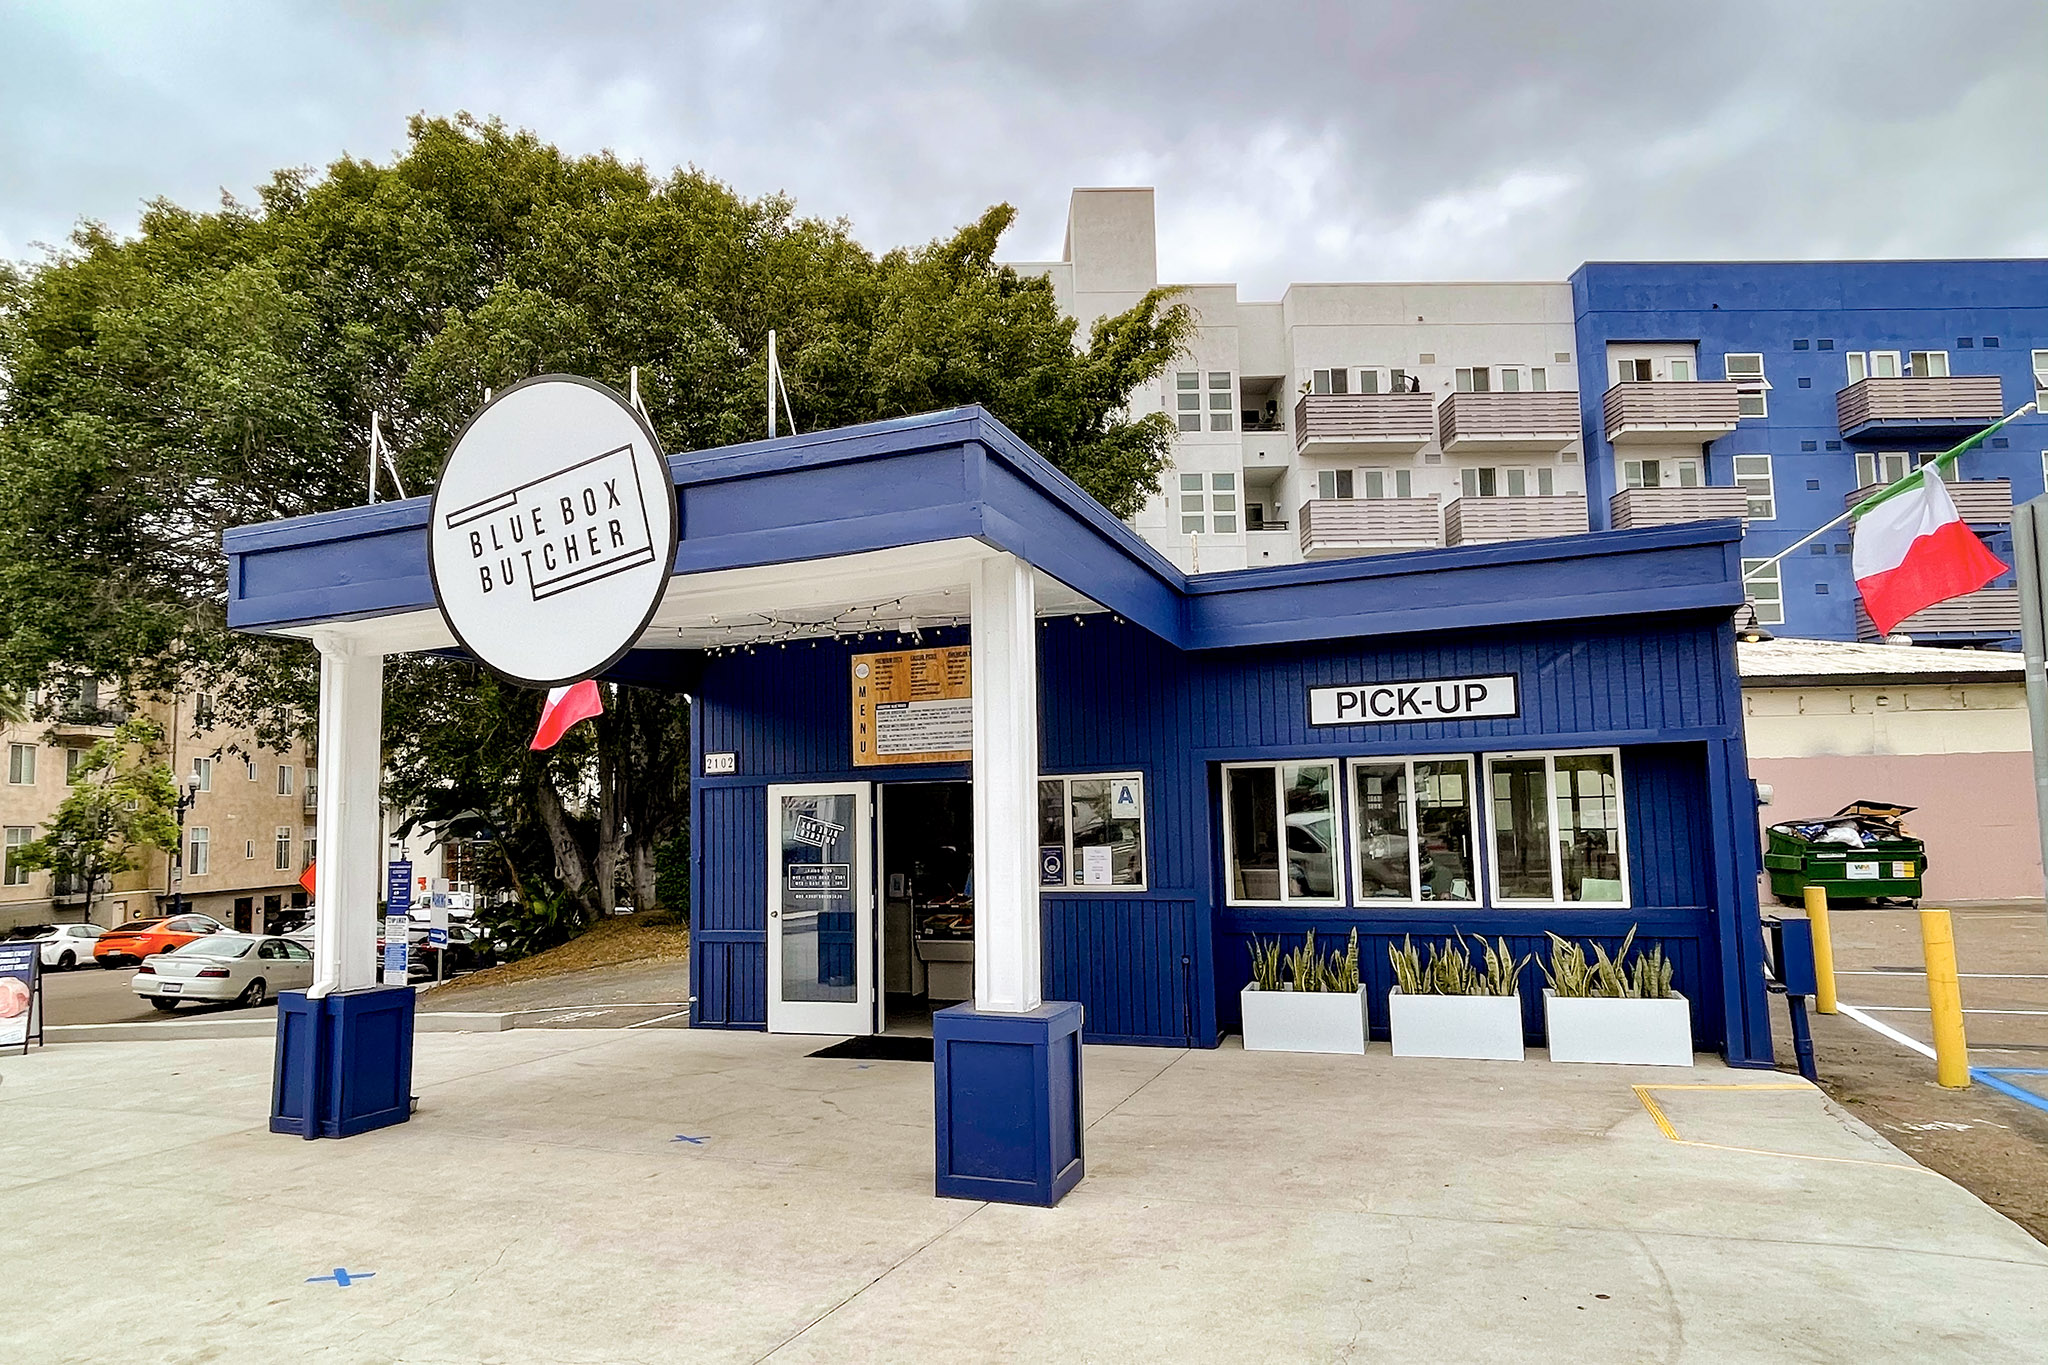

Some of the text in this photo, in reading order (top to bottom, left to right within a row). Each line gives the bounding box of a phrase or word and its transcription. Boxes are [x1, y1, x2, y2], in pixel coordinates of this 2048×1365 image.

[469, 478, 621, 558] BLUE BOX
[478, 518, 625, 594] BUTCHER
[858, 686, 866, 753] MENU
[1335, 683, 1489, 719] PICK-UP
[706, 756, 734, 769] 2102
[1117, 785, 1134, 804] A
